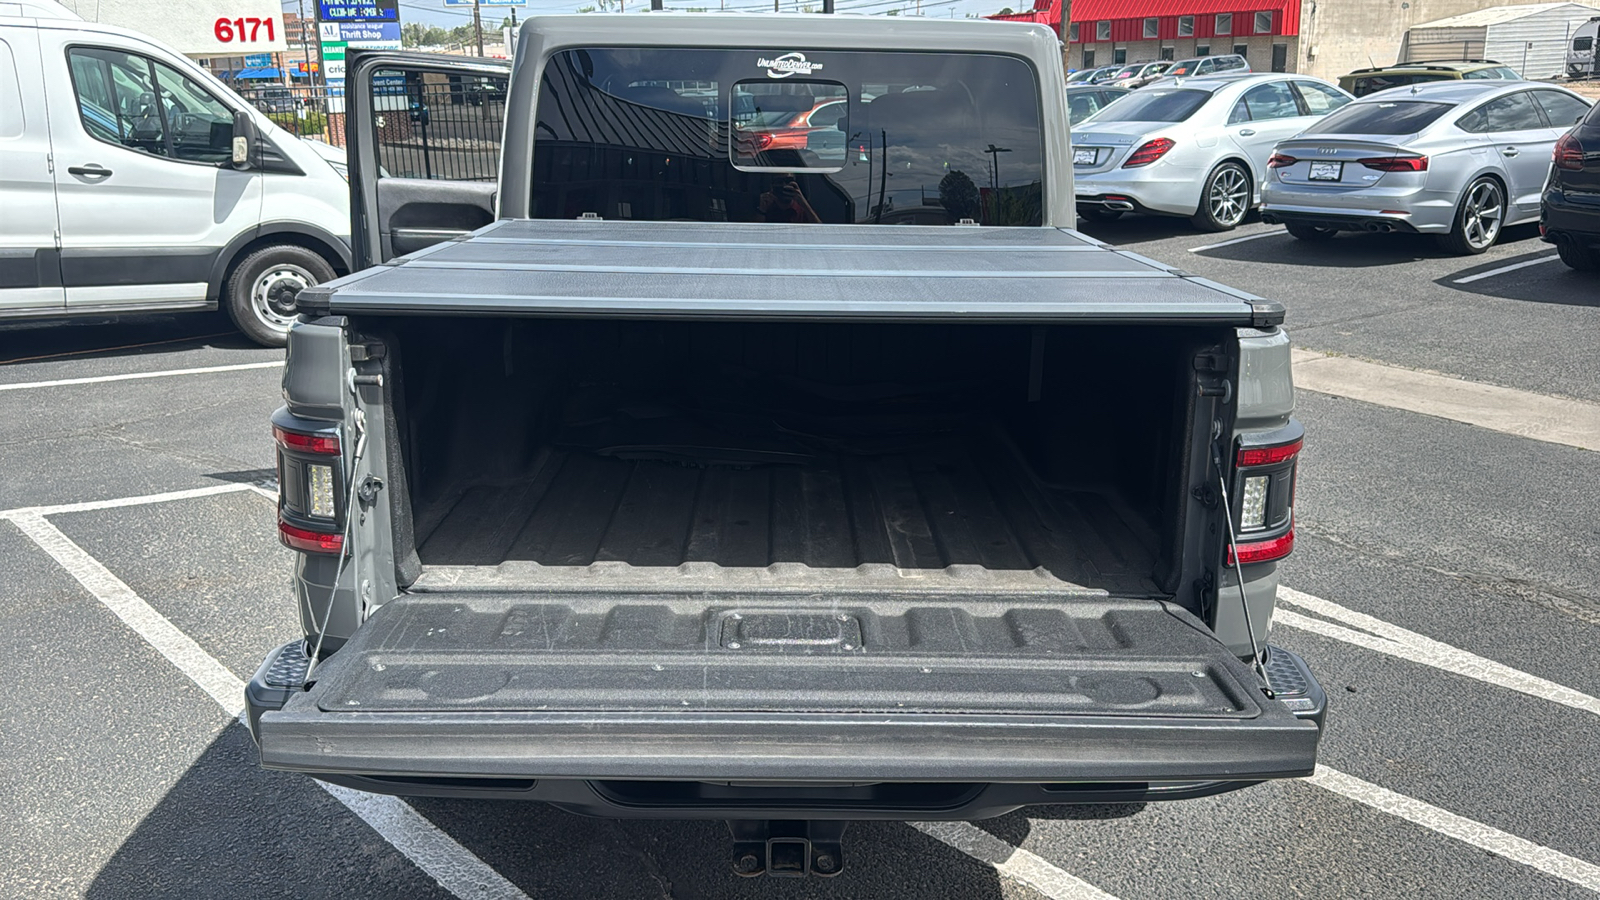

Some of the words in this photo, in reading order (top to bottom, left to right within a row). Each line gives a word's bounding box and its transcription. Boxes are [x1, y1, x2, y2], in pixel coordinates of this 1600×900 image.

[214, 17, 275, 43] 6171
[341, 30, 362, 39] Thrift
[362, 30, 382, 39] Shop
[328, 65, 346, 74] cric
